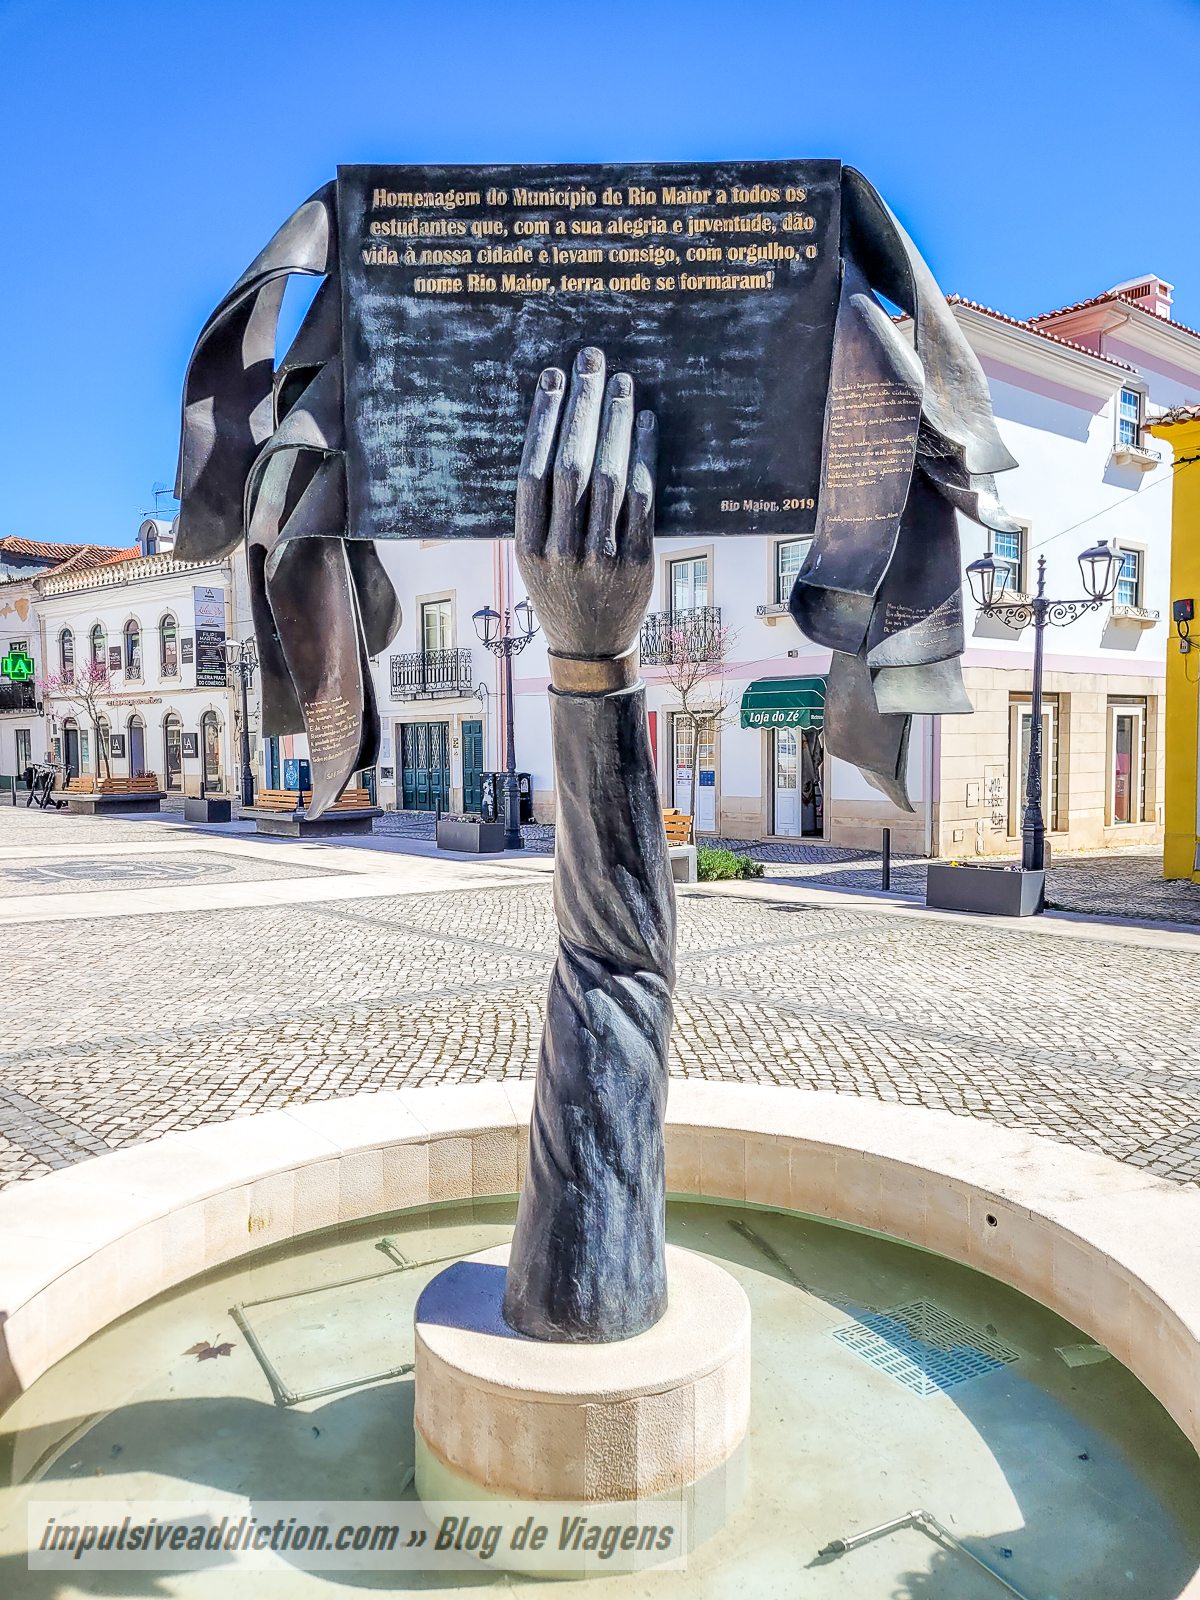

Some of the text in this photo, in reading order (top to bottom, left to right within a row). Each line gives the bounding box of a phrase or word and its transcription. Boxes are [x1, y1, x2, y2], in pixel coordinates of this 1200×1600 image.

[372, 186, 806, 211] Homenagem do Município de Rio Maior a todos os
[370, 213, 814, 240] estudantes que, com a sua alegria e juventude, dão
[362, 243, 817, 267] vida à nossa cidade e levam consigo, com orgulho, o
[414, 272, 774, 294] nome Rio Maior, terra onde se formaram!
[720, 498, 815, 512] Rio Maior, 2019
[750, 710, 799, 724] Loja do Zé
